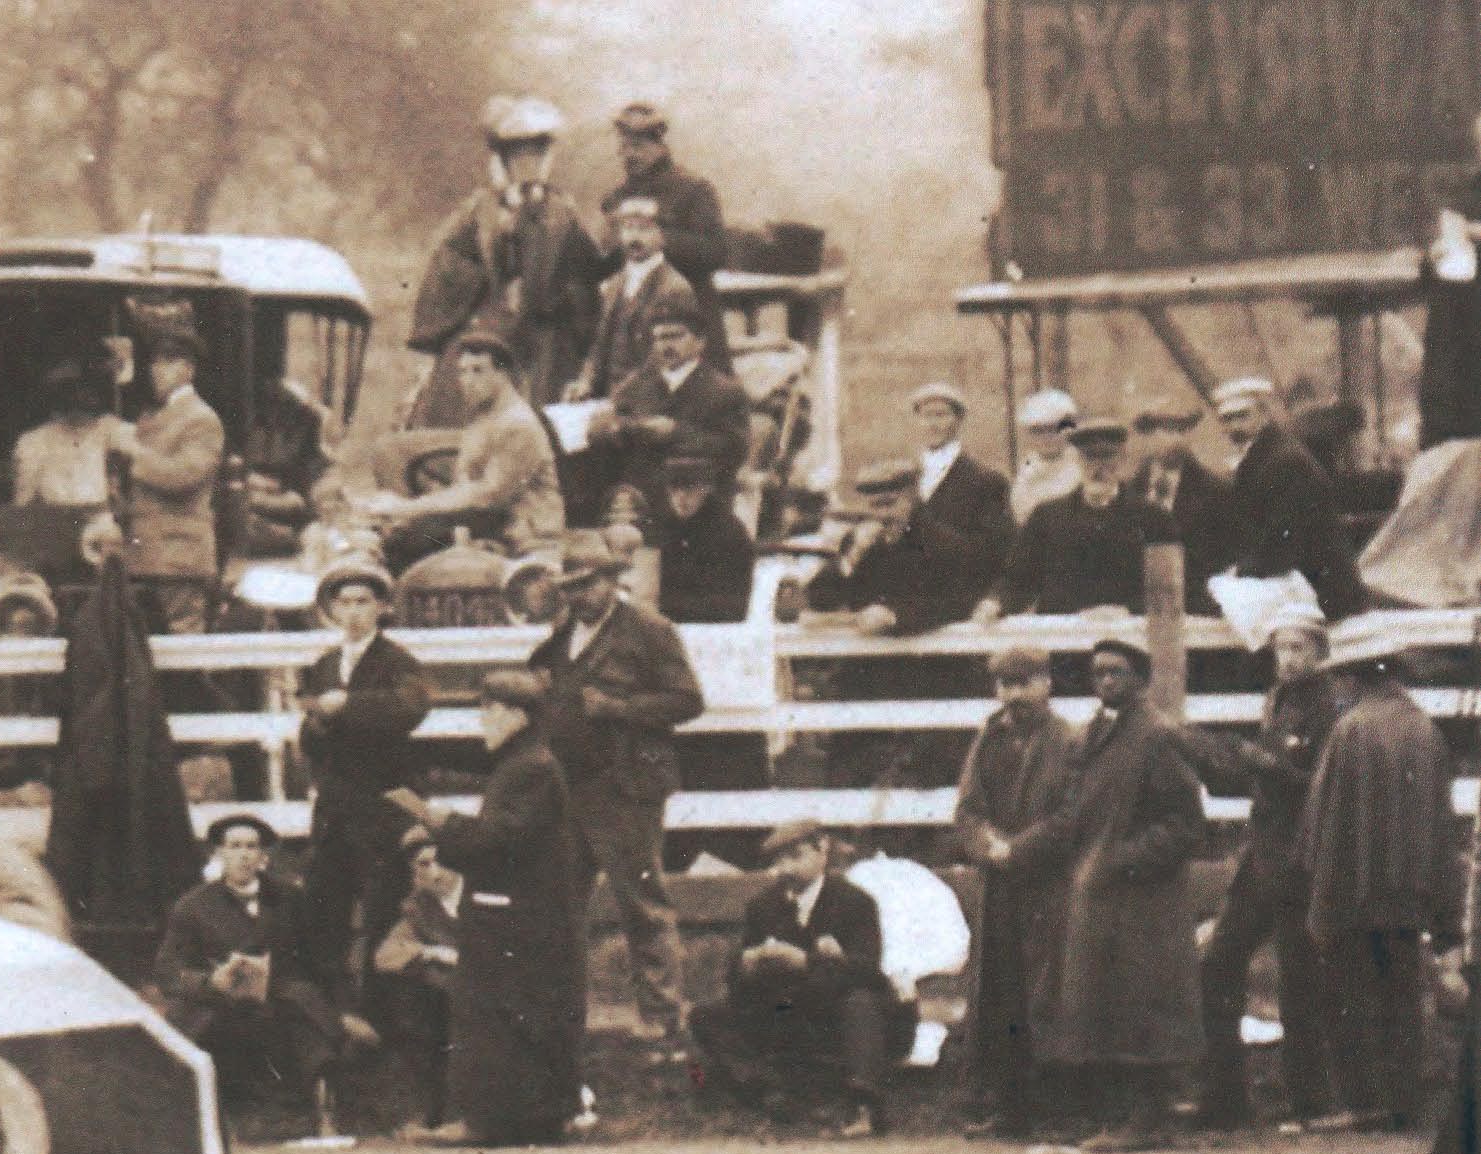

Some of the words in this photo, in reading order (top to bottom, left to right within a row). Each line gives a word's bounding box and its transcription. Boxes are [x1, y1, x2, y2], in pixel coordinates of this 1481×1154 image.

[1041, 168, 1108, 253] 31
[1130, 163, 1181, 253] &
[1201, 162, 1290, 249] 33
